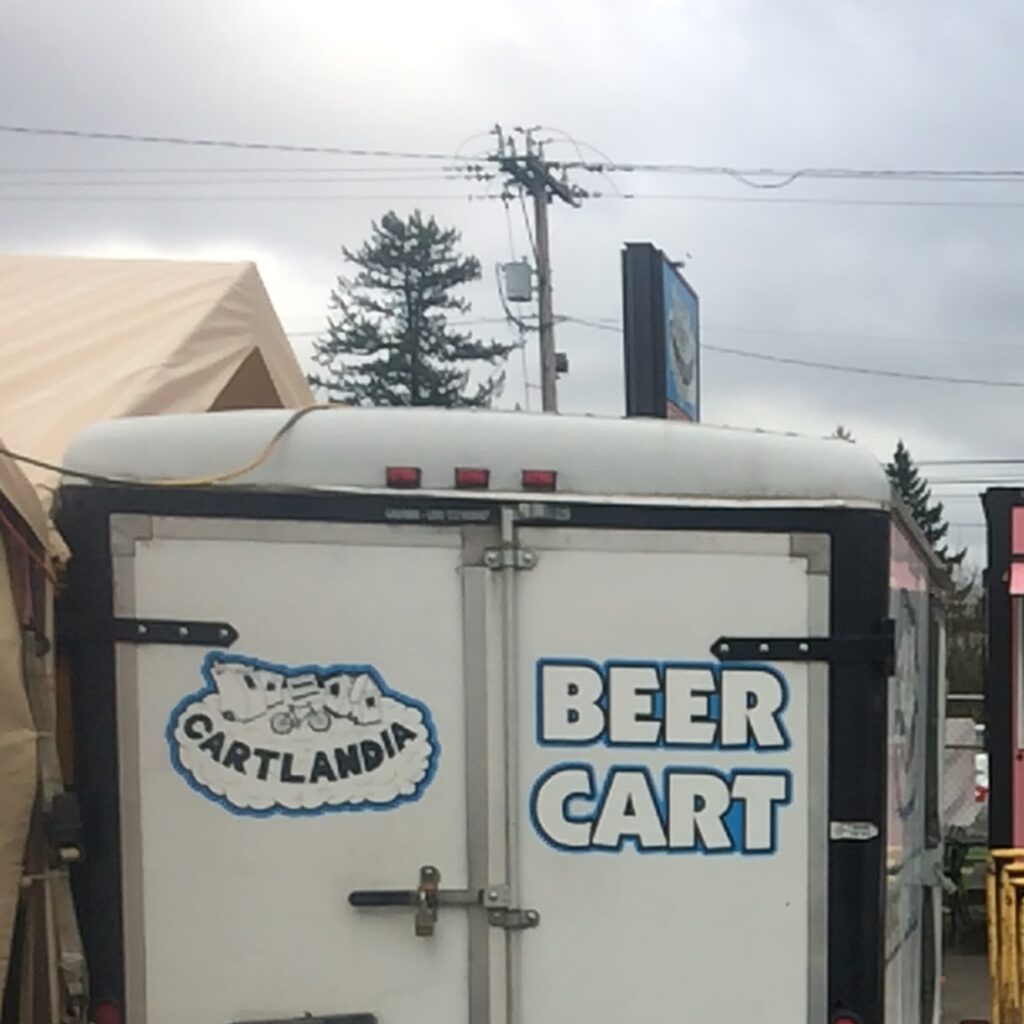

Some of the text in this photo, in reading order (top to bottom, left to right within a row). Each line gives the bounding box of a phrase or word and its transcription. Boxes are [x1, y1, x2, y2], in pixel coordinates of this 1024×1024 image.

[183, 713, 417, 784] CARTLANDIA
[538, 660, 789, 750] BEER
[533, 763, 790, 853] CART
